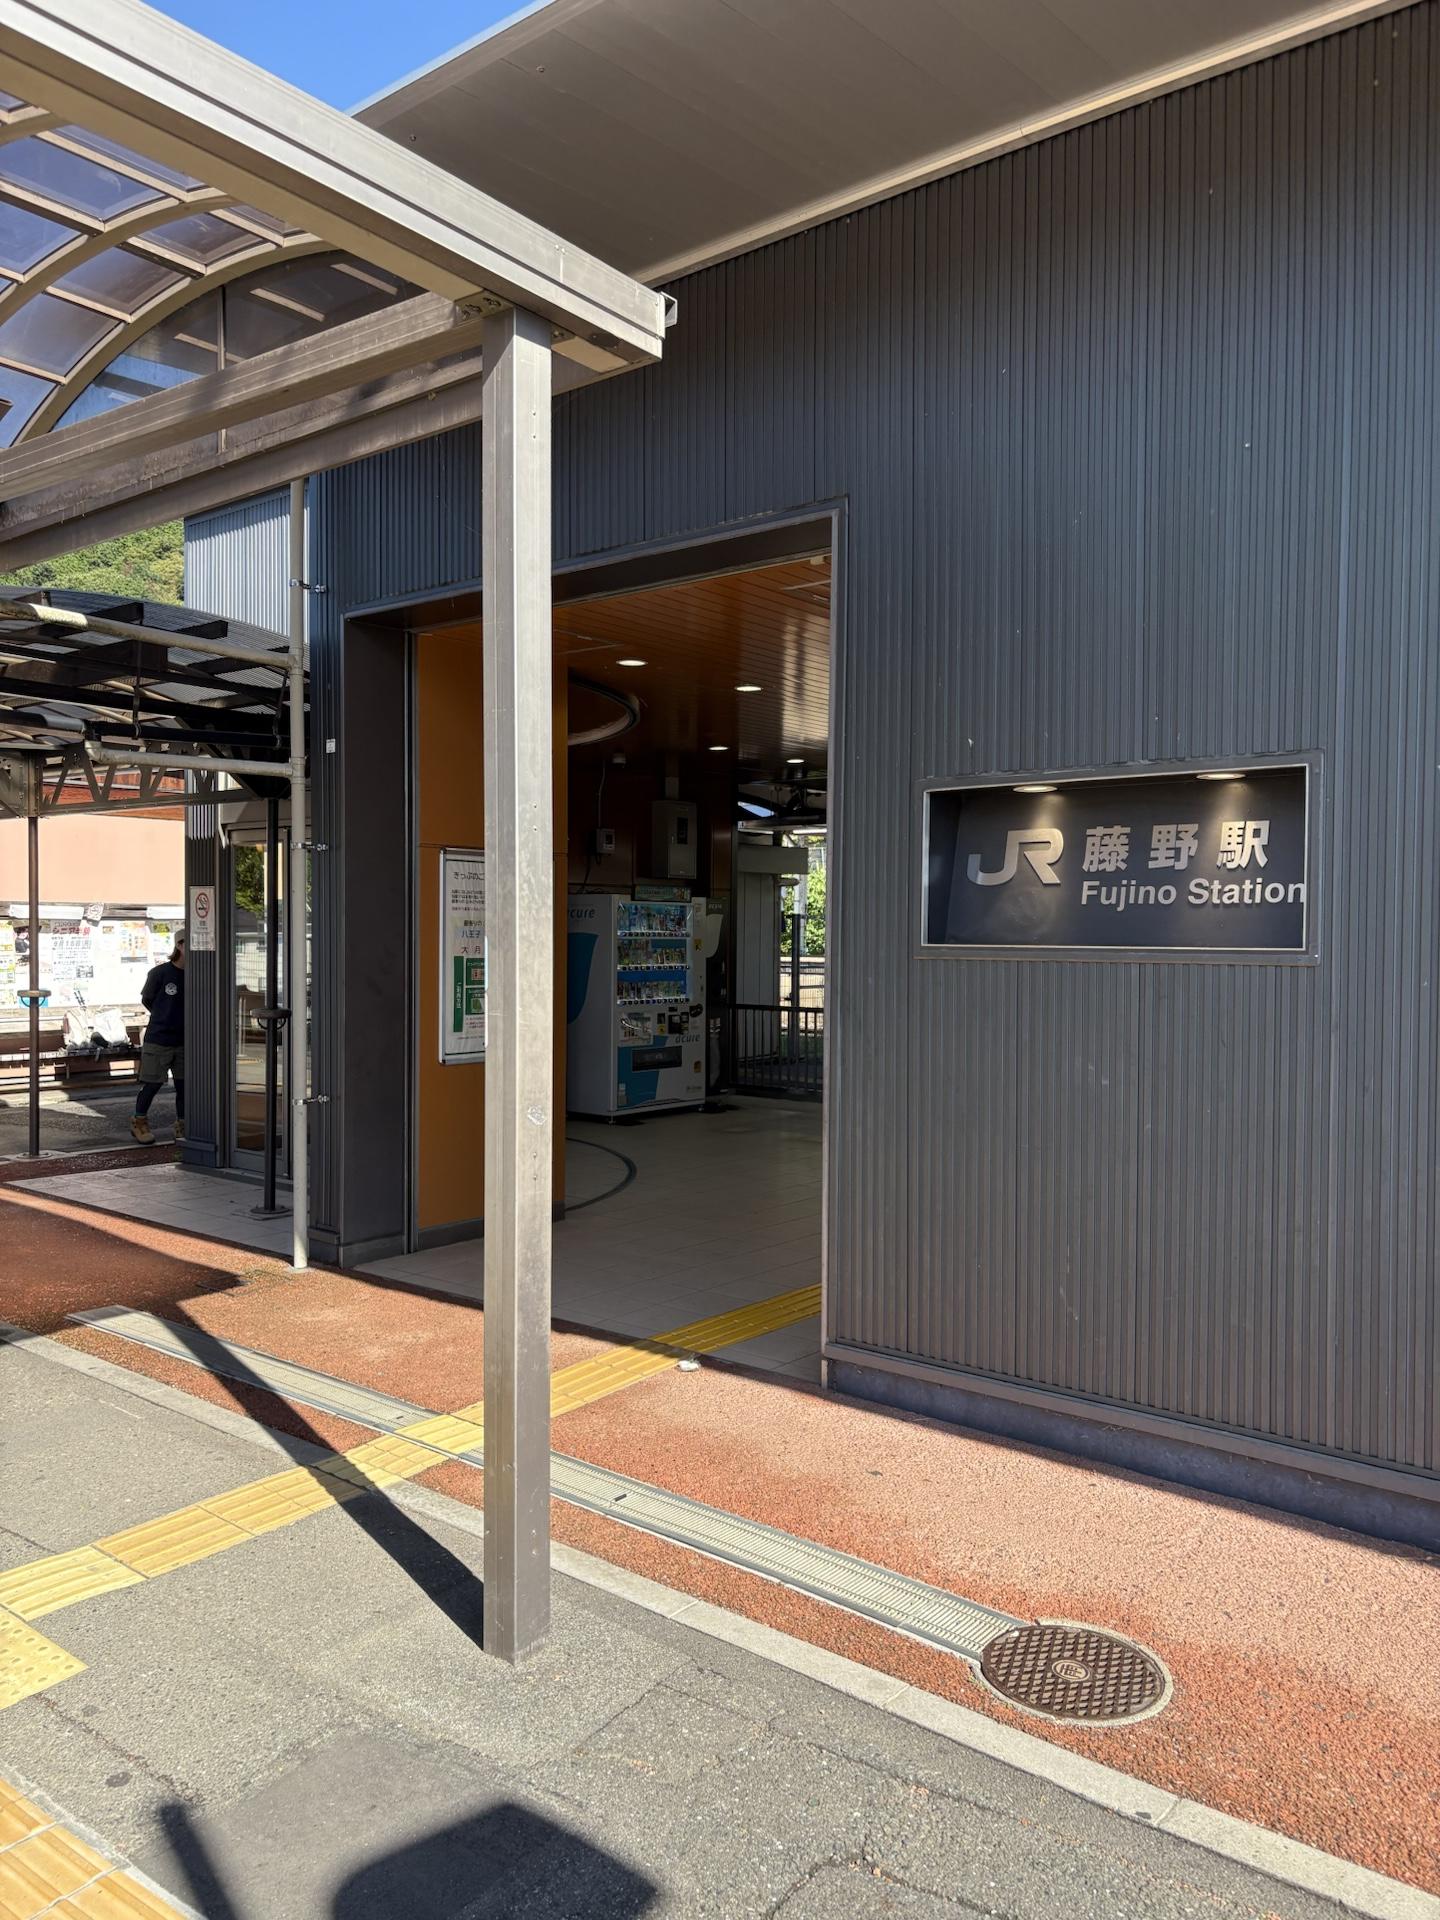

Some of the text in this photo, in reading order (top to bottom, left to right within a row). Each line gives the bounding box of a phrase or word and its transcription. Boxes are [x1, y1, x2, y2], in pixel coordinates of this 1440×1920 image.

[966, 827, 1064, 887] JR
[1081, 819, 1270, 873] 藤野駅
[567, 908, 595, 918] cure
[1080, 877, 1305, 912] Fujino Station
